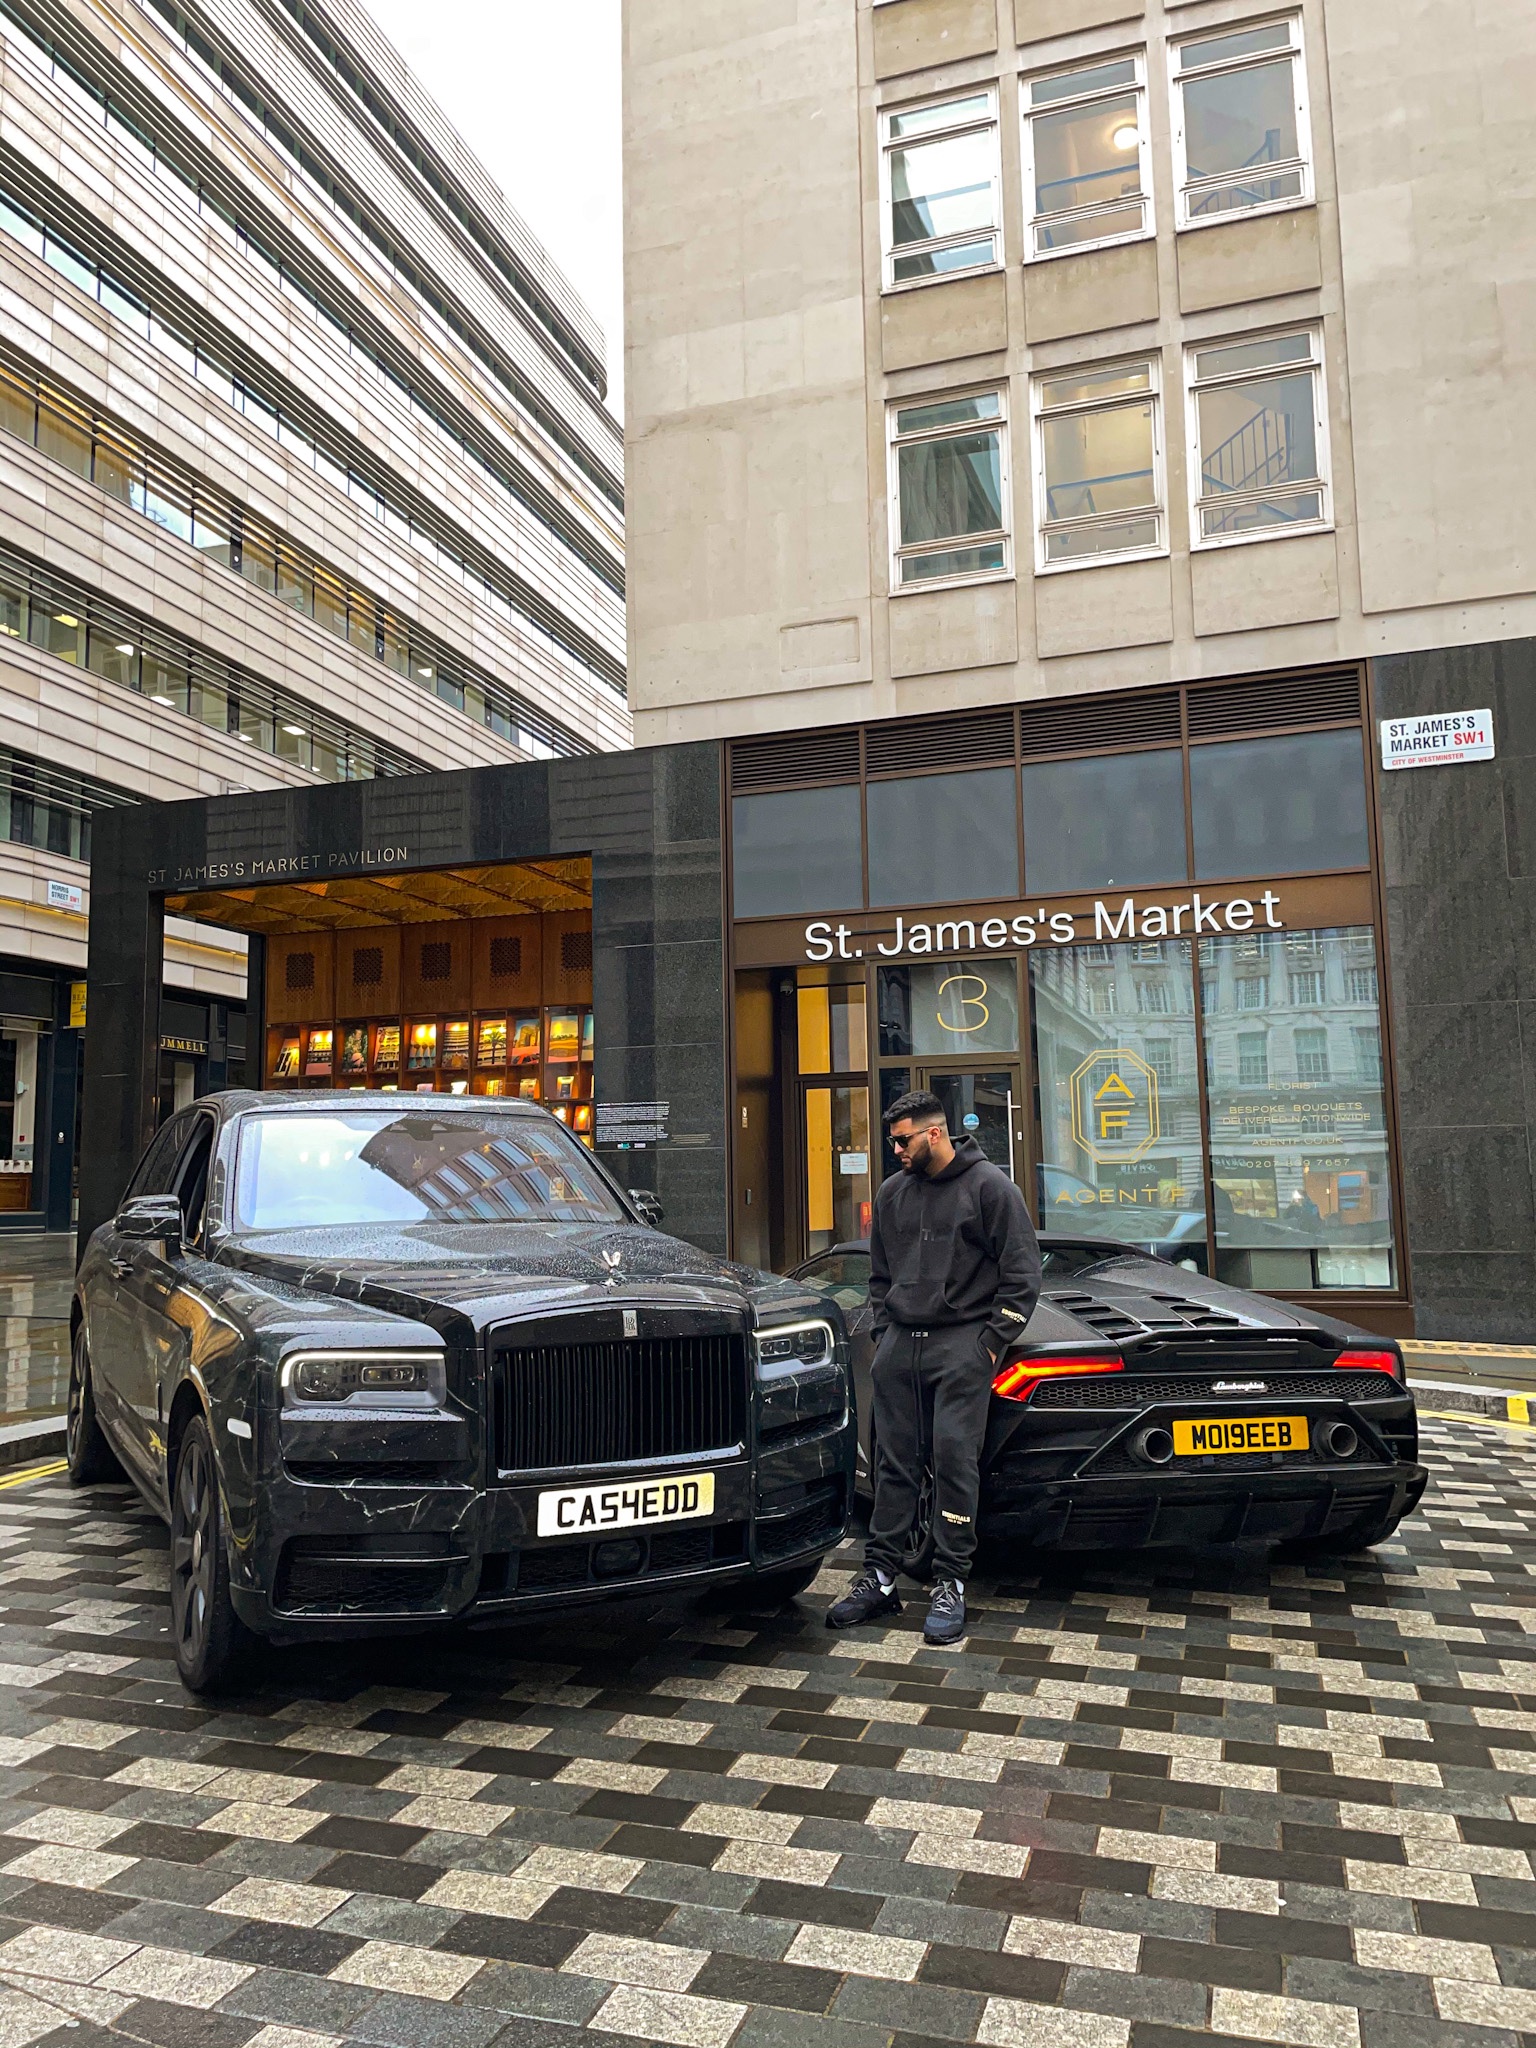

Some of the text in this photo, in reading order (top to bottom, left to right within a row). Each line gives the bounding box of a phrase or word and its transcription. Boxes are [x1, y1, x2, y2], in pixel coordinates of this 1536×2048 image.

[1390, 716, 1475, 737] ST. JAMES'S
[1391, 731, 1484, 752] MARKET SW1
[1408, 757, 1416, 765] OF
[1418, 752, 1464, 763] WESTMINSTER
[148, 846, 408, 884] ST JAMES'S MARKET PAVILION
[51, 884, 69, 894] NORRIS
[51, 891, 69, 901] STREET
[804, 890, 1284, 961] St. James's Market
[936, 975, 990, 1032] 3
[1094, 1073, 1136, 1100] A
[1268, 1082, 1318, 1091] FLORIST
[1229, 1102, 1363, 1114] BESPOKE BOUQUETS
[1101, 1110, 1131, 1138] F
[1222, 1112, 1371, 1125] DELIVERED NATIONWIDE
[1055, 1188, 1158, 1204] AGENT
[1212, 1381, 1265, 1391] Lamborghini
